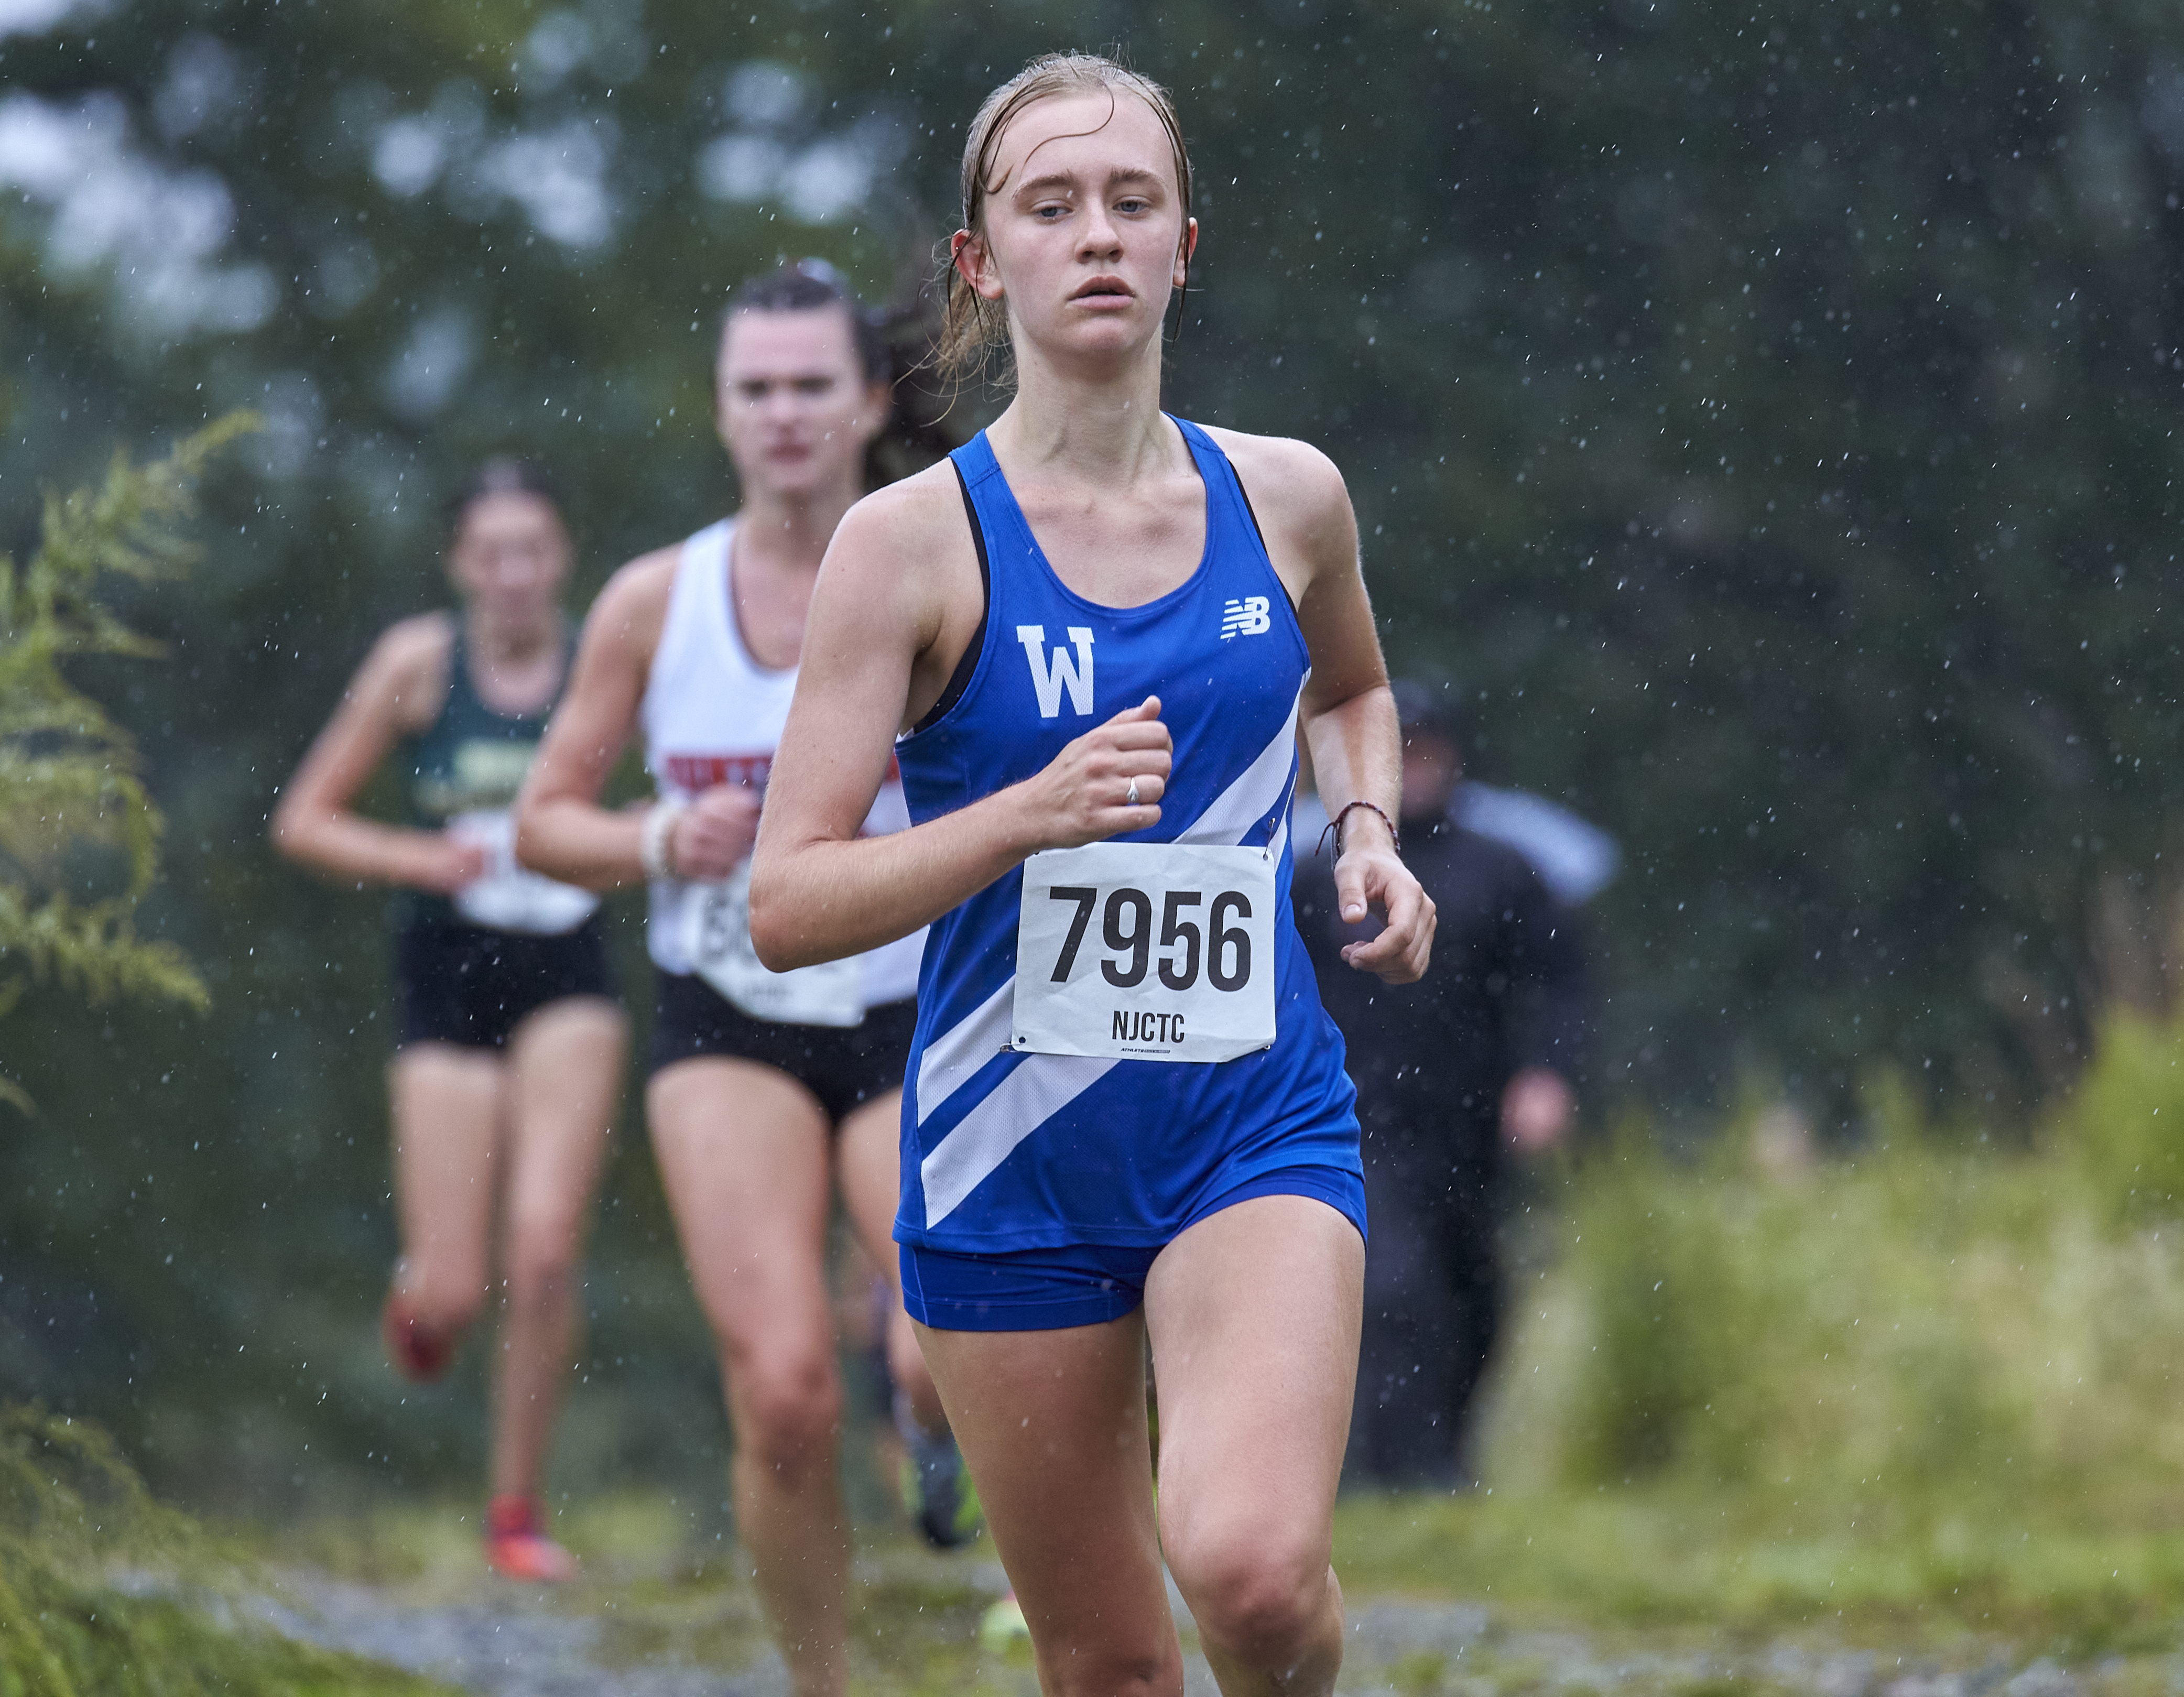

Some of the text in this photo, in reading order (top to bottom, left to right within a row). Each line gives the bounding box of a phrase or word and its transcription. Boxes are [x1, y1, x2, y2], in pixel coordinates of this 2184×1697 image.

[1016, 625, 1095, 718] W
[1049, 886, 1252, 992] 7956
[1112, 1010, 1185, 1043] NJCTC
